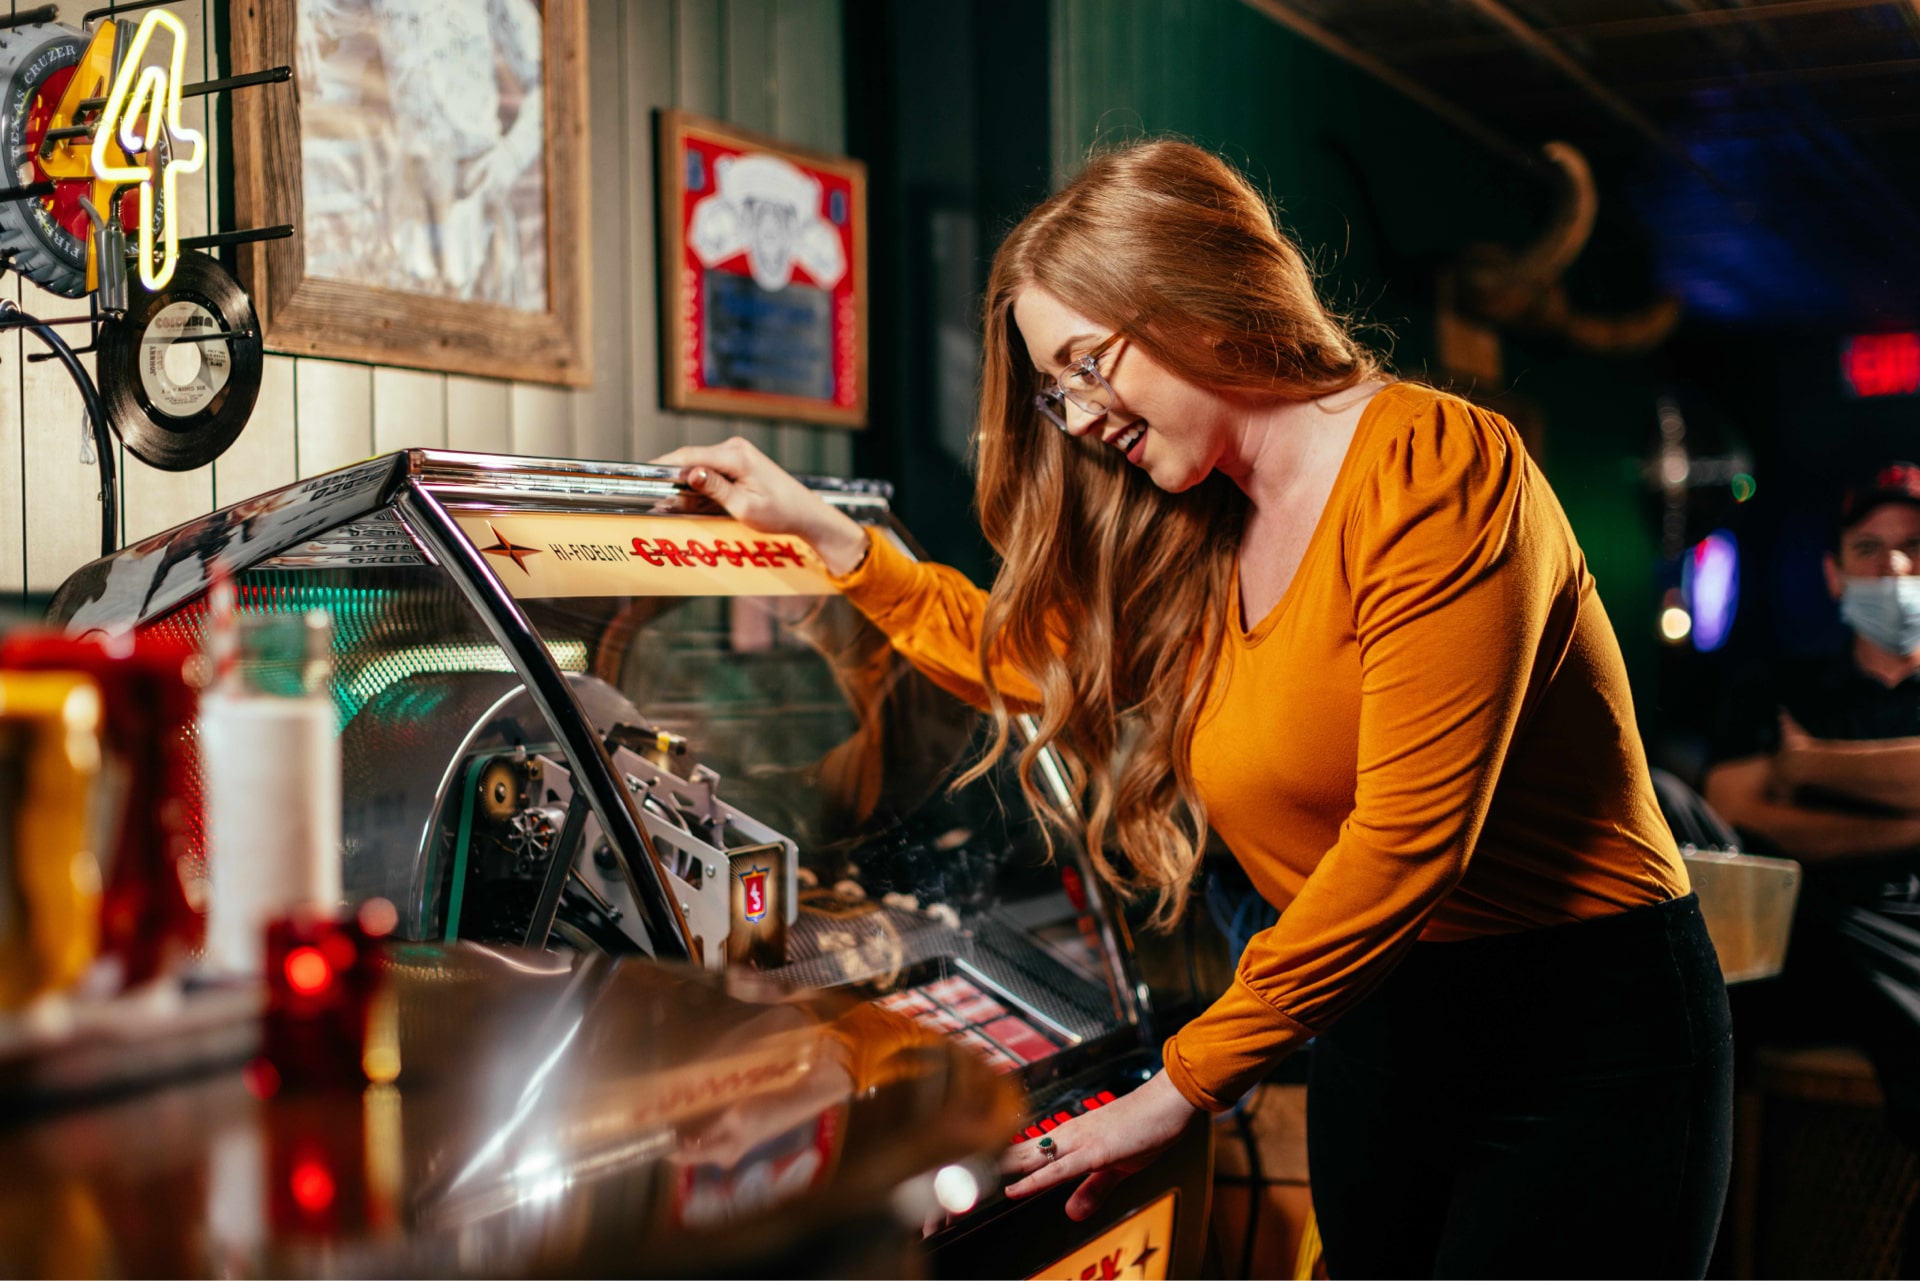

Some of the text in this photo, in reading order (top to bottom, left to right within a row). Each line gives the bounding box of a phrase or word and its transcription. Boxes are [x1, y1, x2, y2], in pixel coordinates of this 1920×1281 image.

[10, 44, 76, 158] TEXAS CRUZER
[93, 9, 206, 291] 4
[149, 346, 157, 376] JOHNNY
[548, 537, 806, 568] HI-FIDELITY CROSLEY
